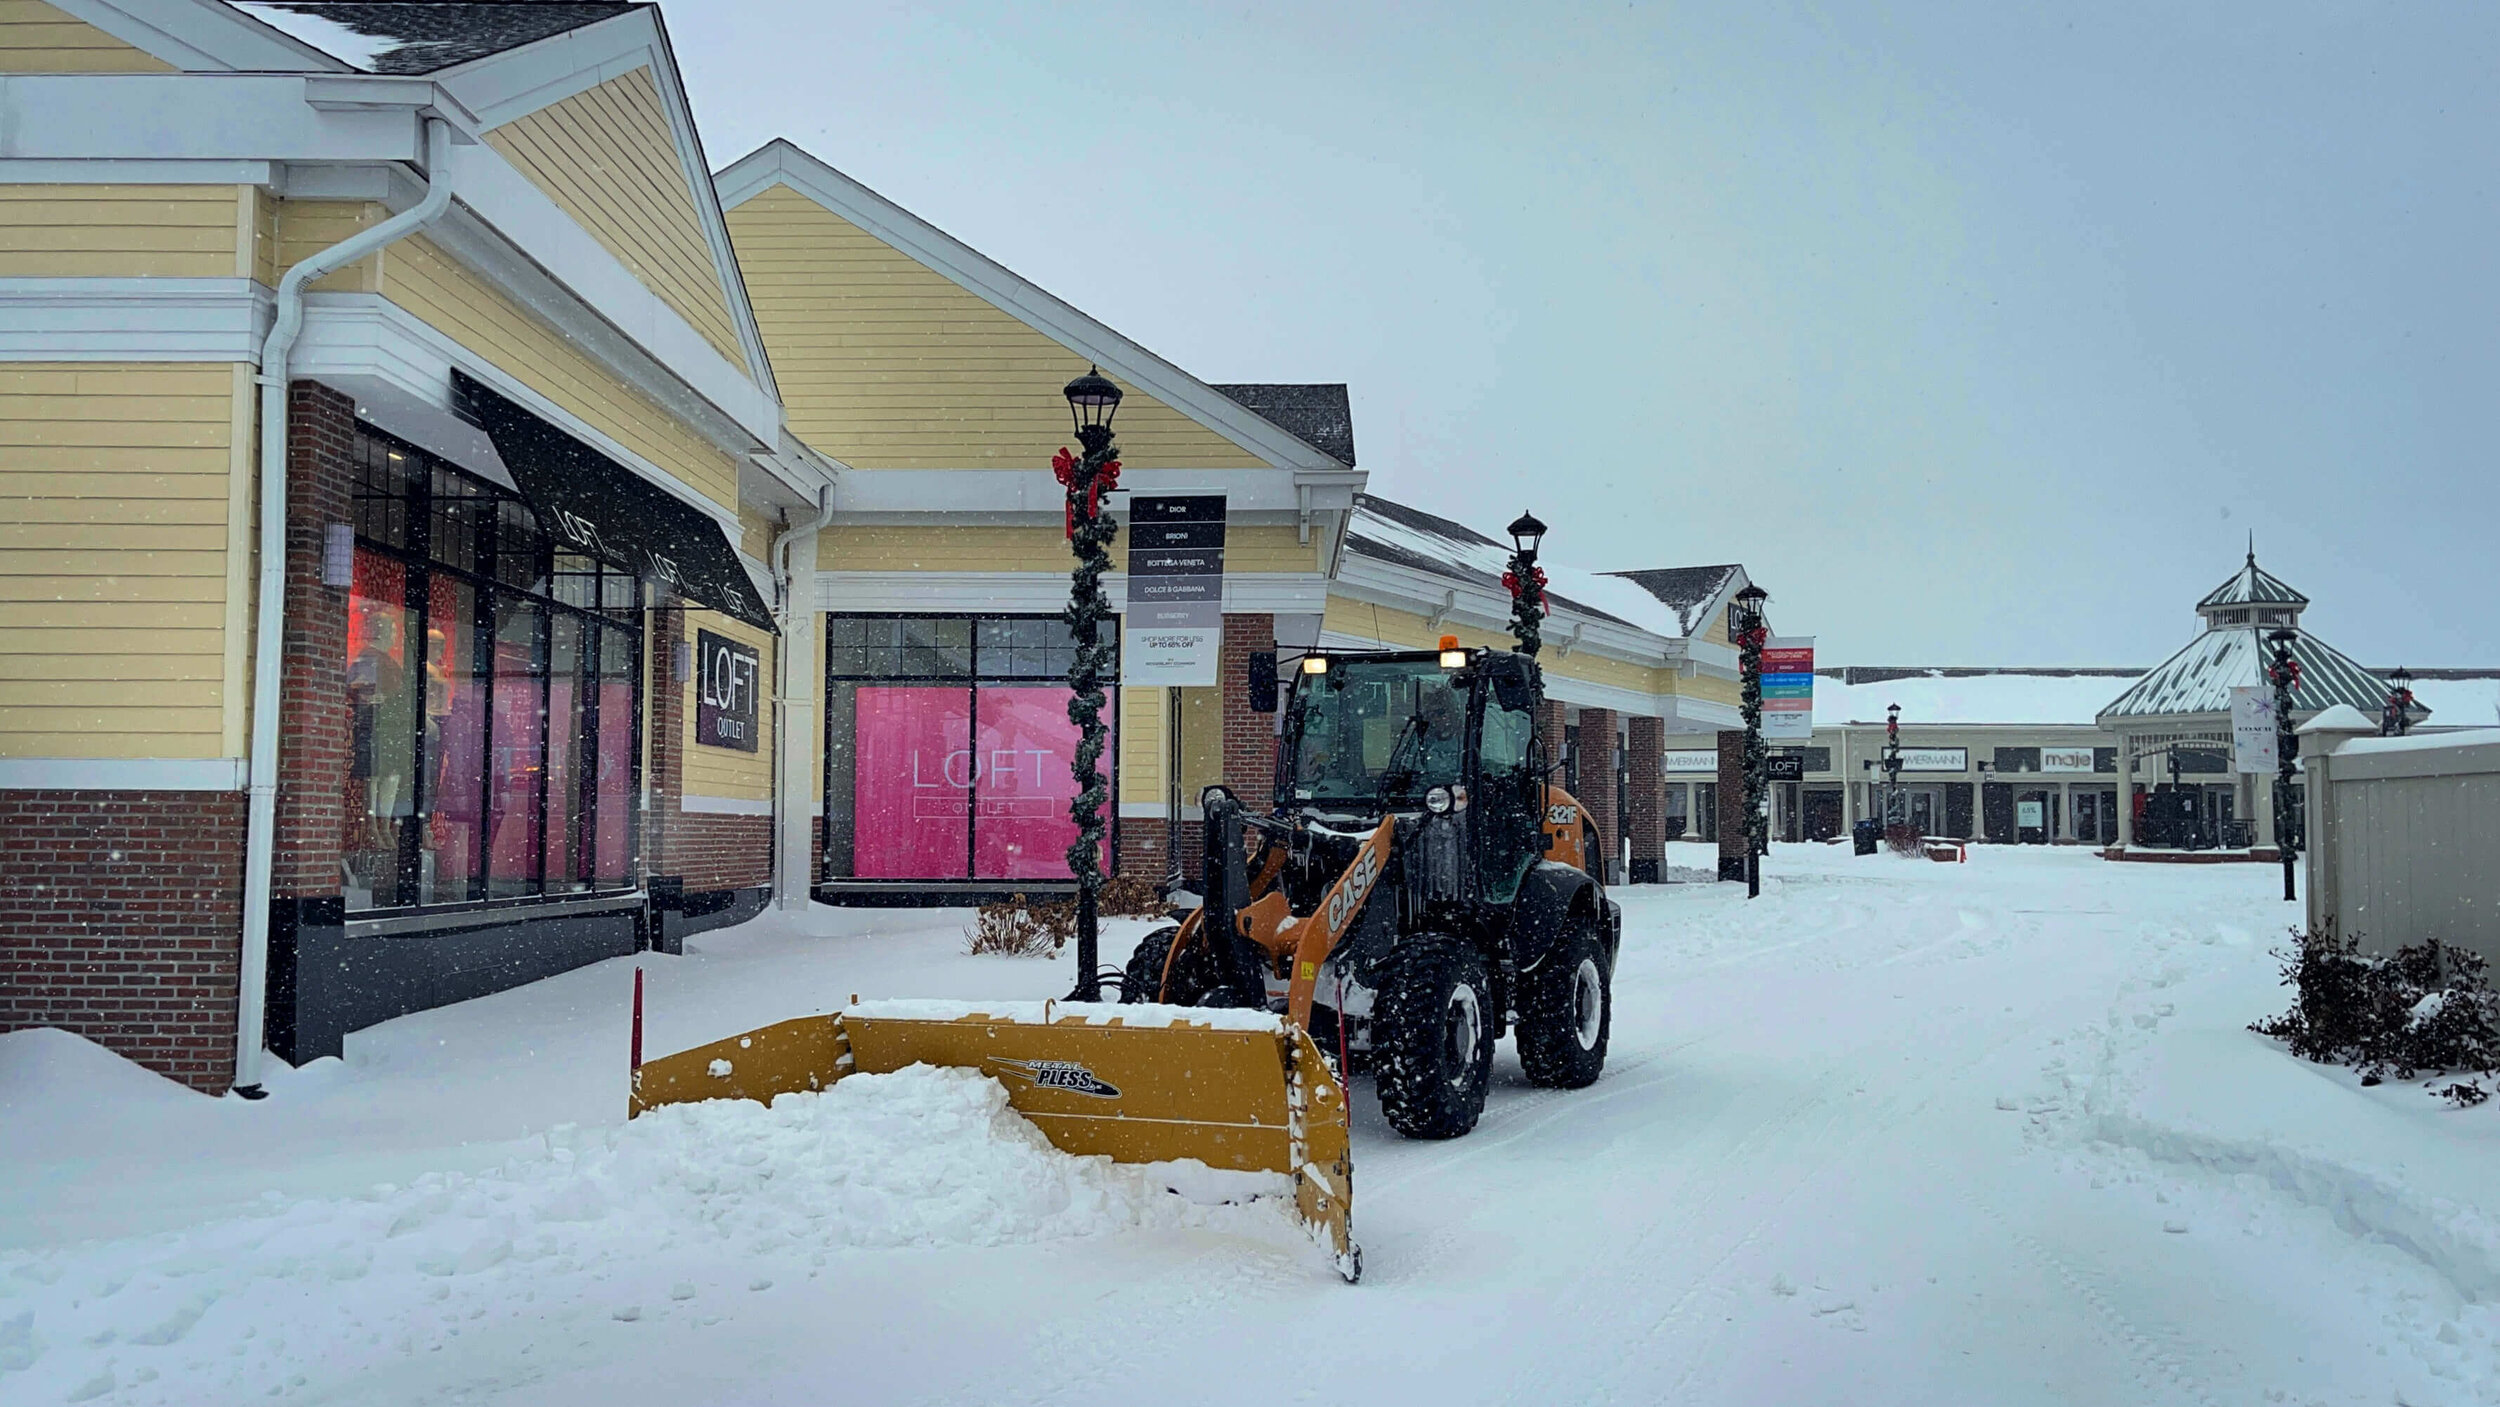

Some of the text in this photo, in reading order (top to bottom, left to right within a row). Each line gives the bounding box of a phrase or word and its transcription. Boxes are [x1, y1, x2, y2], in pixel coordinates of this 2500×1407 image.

[551, 505, 607, 554] LOFT
[645, 549, 689, 590] LOFT
[1146, 558, 1205, 567] BOTTEGA VENETA
[1144, 586, 1167, 594] DOLCE
[1172, 585, 1206, 593] GABBANA
[703, 641, 757, 715] LOFT
[717, 716, 744, 740] OUTLET
[913, 750, 1053, 788] LOFT
[1769, 761, 1800, 772] LOFT
[2045, 752, 2092, 768] maje
[1549, 804, 1577, 824] 321F
[1328, 844, 1378, 932] CASE
[1028, 1061, 1079, 1070] METAL
[1038, 1070, 1091, 1087] PLESS
